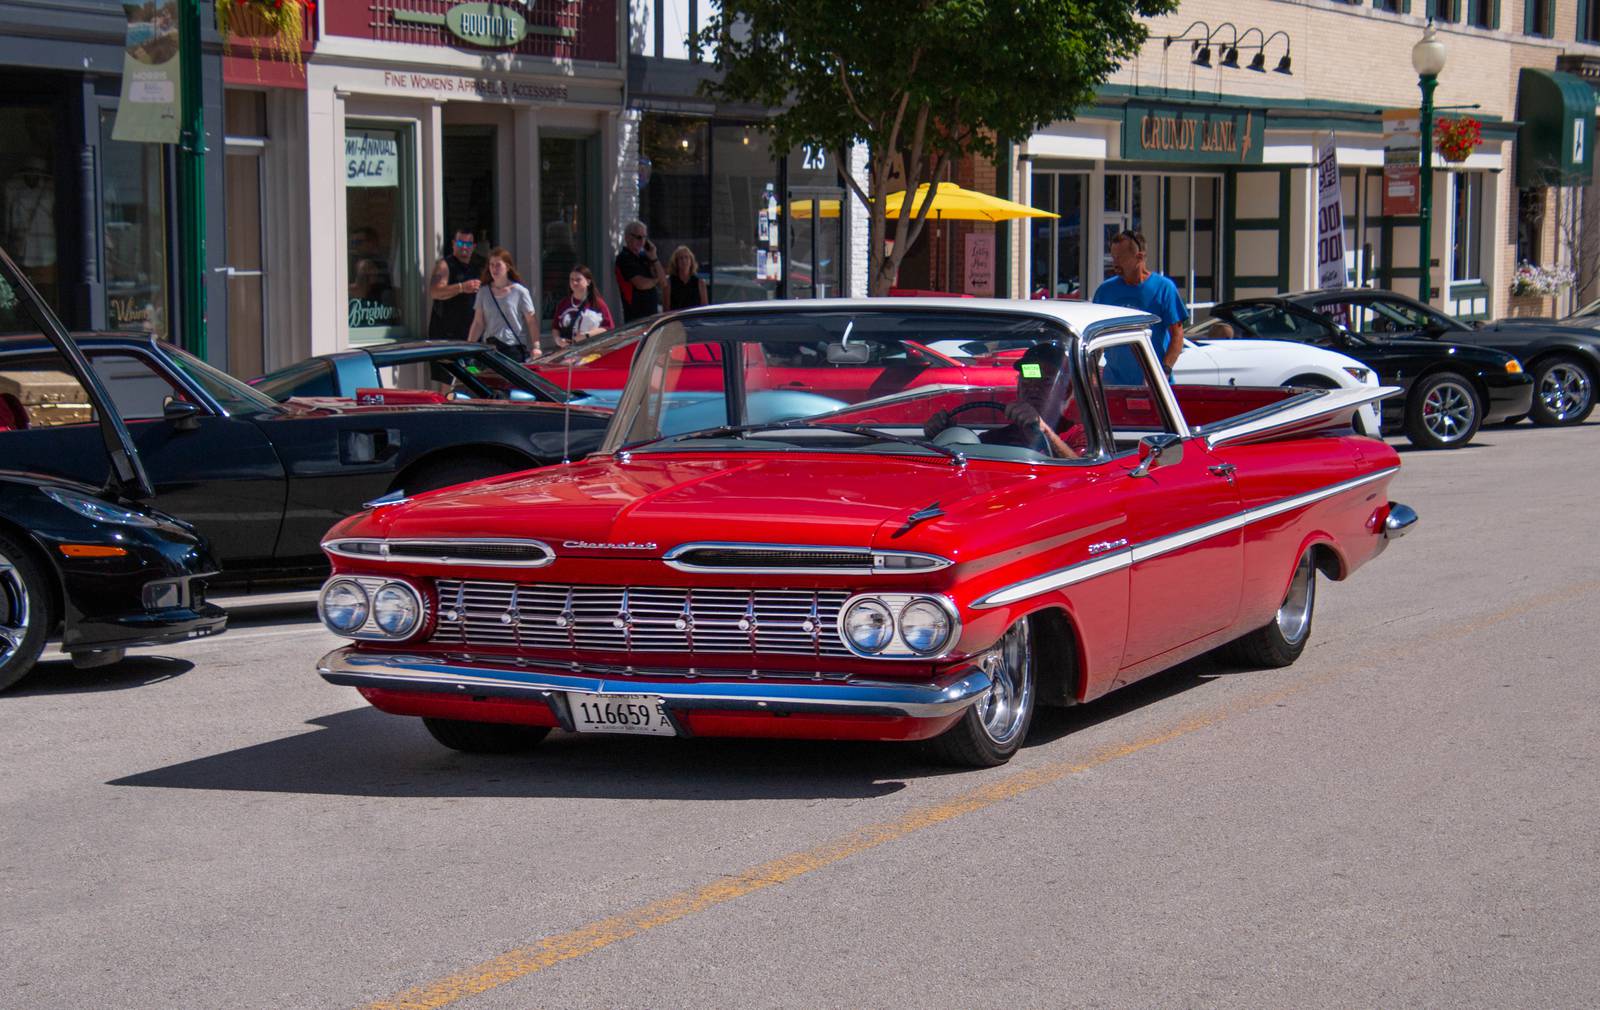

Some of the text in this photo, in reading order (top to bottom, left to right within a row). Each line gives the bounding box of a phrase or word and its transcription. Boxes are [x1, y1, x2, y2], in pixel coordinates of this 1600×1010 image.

[384, 71, 407, 88] FINE
[512, 81, 568, 99] ACCESSORIES
[348, 160, 384, 179] SALE
[563, 540, 657, 550] Chevrolet
[581, 702, 649, 726] 116659
